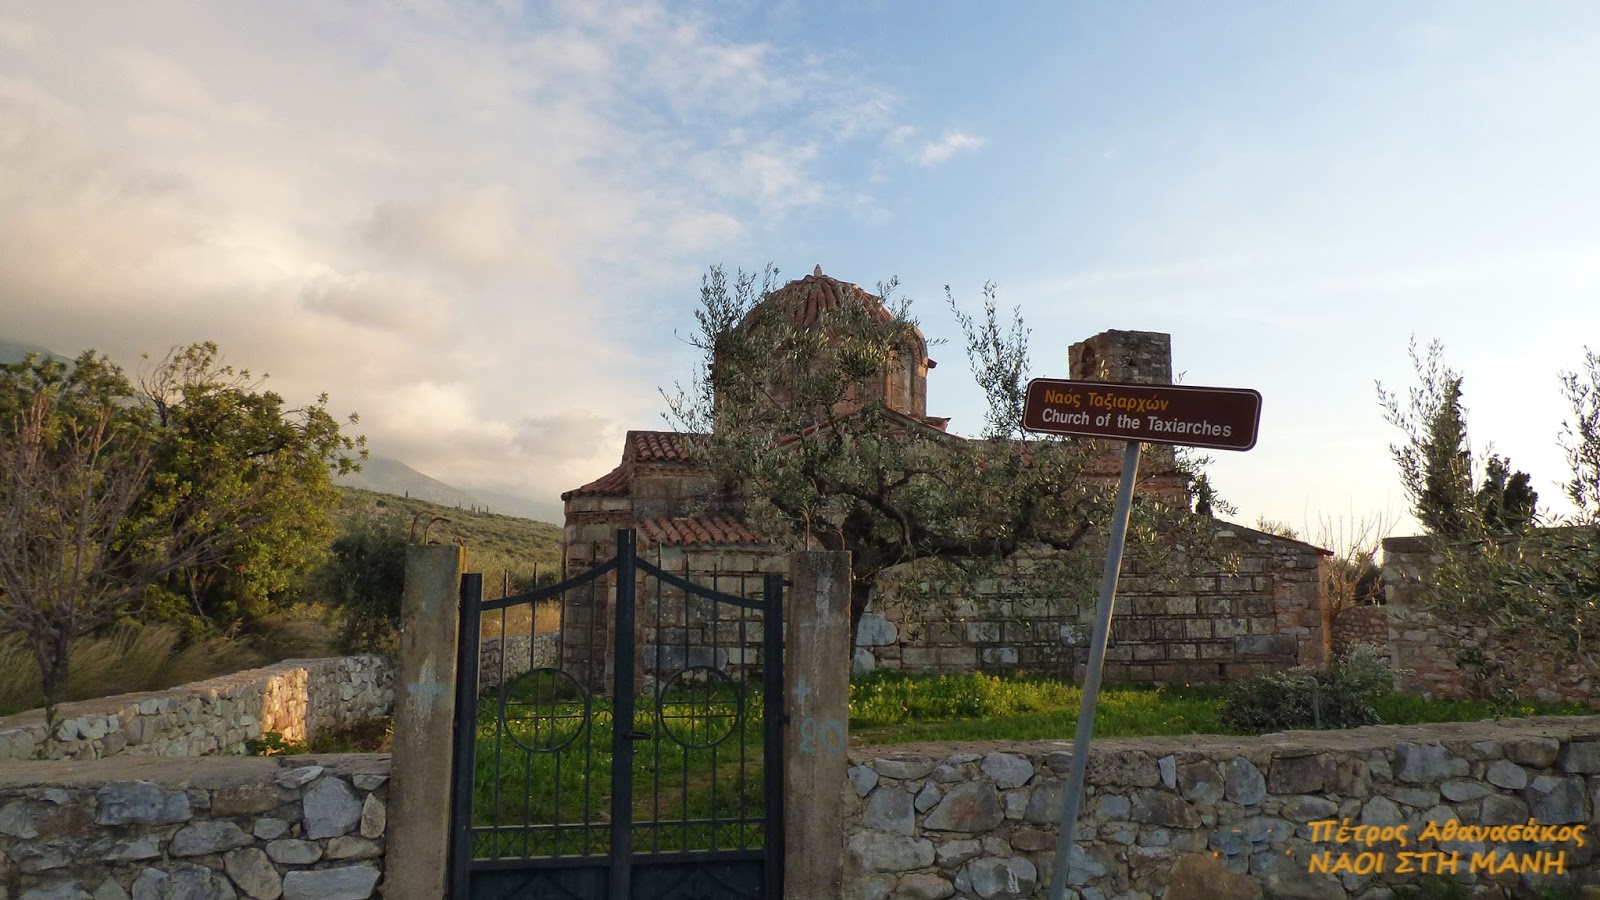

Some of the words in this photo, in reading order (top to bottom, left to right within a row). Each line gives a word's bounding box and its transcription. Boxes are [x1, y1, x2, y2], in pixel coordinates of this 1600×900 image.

[1044, 388, 1081, 407] Ναός
[1088, 391, 1169, 412] Ταξιαρχών
[1042, 408, 1090, 427] Church
[1095, 413, 1110, 428] of
[1117, 414, 1140, 430] the
[1147, 415, 1232, 437] Taxiarches
